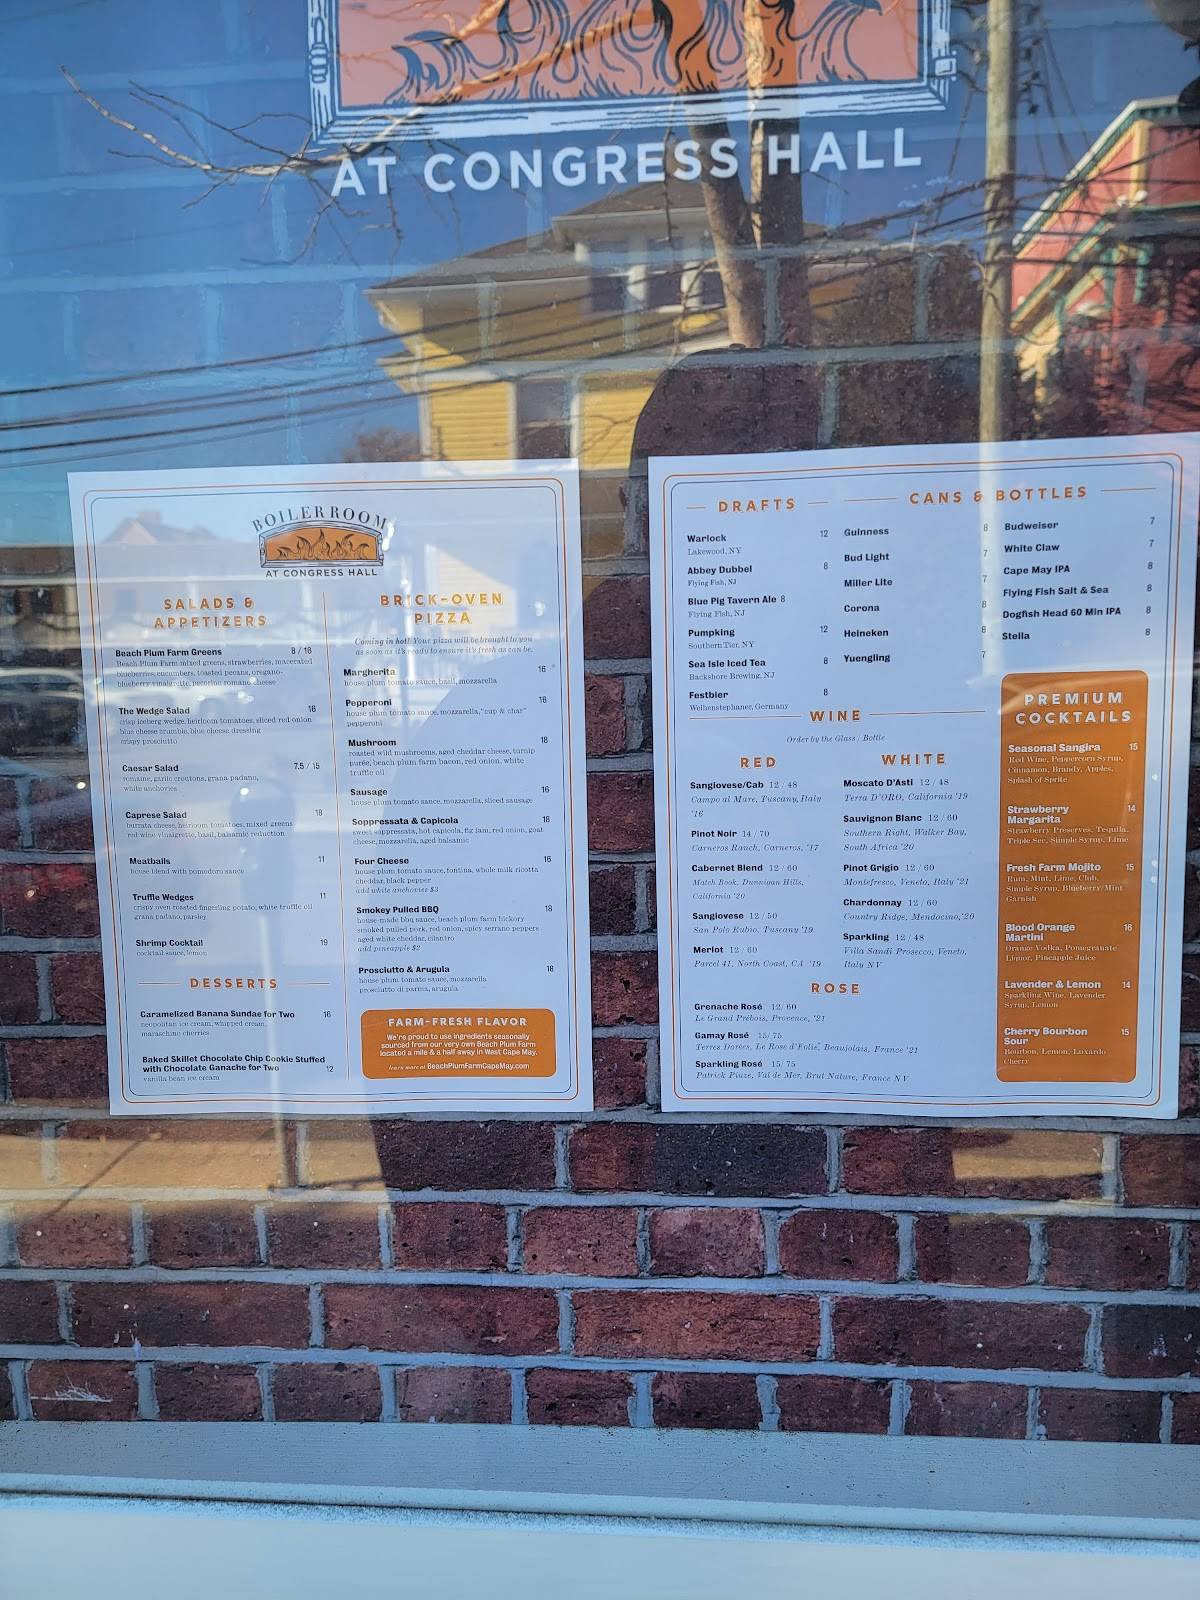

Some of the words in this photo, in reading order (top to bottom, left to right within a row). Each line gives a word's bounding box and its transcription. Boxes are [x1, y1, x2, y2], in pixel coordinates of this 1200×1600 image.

[331, 157, 392, 197] AT
[424, 141, 741, 194] CONGRESS
[769, 128, 923, 175] HALL
[910, 492, 962, 504] CANS
[974, 491, 983, 502] &
[996, 486, 1087, 500] BOTTLES
[718, 499, 795, 512] DRAFTS
[1005, 522, 1058, 530] Budweiser
[844, 528, 889, 536] Guinness
[865, 553, 889, 562] Light
[283, 568, 344, 577] CONGRESS
[688, 566, 716, 575] Abbey
[1003, 588, 1033, 597] Flying
[164, 597, 234, 609] SALADS
[244, 597, 253, 608] &
[380, 592, 503, 606] BRICK-OVEN
[710, 597, 724, 606] Pig
[415, 612, 471, 624] PIZZA
[1003, 610, 1040, 619] Dogfish
[154, 616, 267, 629] APPETIZERS
[688, 629, 735, 637] Pumpking
[844, 654, 890, 663] Yuengling
[343, 668, 395, 677] Margherita
[346, 699, 392, 708] Pepperoni
[1024, 692, 1123, 706] PREMIUM
[136, 708, 164, 716] Wedge
[810, 710, 861, 721] WINE
[1015, 710, 1131, 724] COCKTAILS
[1008, 744, 1056, 753] Seasonal
[1059, 744, 1100, 753] Sangira
[741, 757, 777, 768] RED
[882, 754, 945, 764] WHITE
[690, 781, 763, 790] Sangiovese/Cab
[1007, 805, 1069, 814] Strawberry
[352, 818, 408, 826] Soppressata
[421, 817, 458, 825] Capicola
[1007, 816, 1061, 825] Margarita
[1068, 863, 1101, 872] Mojito
[162, 893, 194, 902] Wedges
[843, 899, 902, 907] Chardonnay
[357, 906, 390, 915] Smokey
[421, 905, 439, 914] BBQ
[692, 912, 744, 920] Sangiovese
[1036, 924, 1075, 932] Orange
[843, 933, 889, 942] Sparkling
[416, 966, 450, 974] Arugula
[190, 978, 277, 988] DESSERTS
[811, 983, 860, 994] ROSE
[388, 1018, 471, 1026] FARM-FRESH
[477, 1017, 527, 1026] FLAVOR
[453, 1032, 492, 1040] ingredients
[695, 1032, 725, 1040] Gamay
[728, 1031, 749, 1039] Rosé
[1004, 1028, 1040, 1037] Cherry
